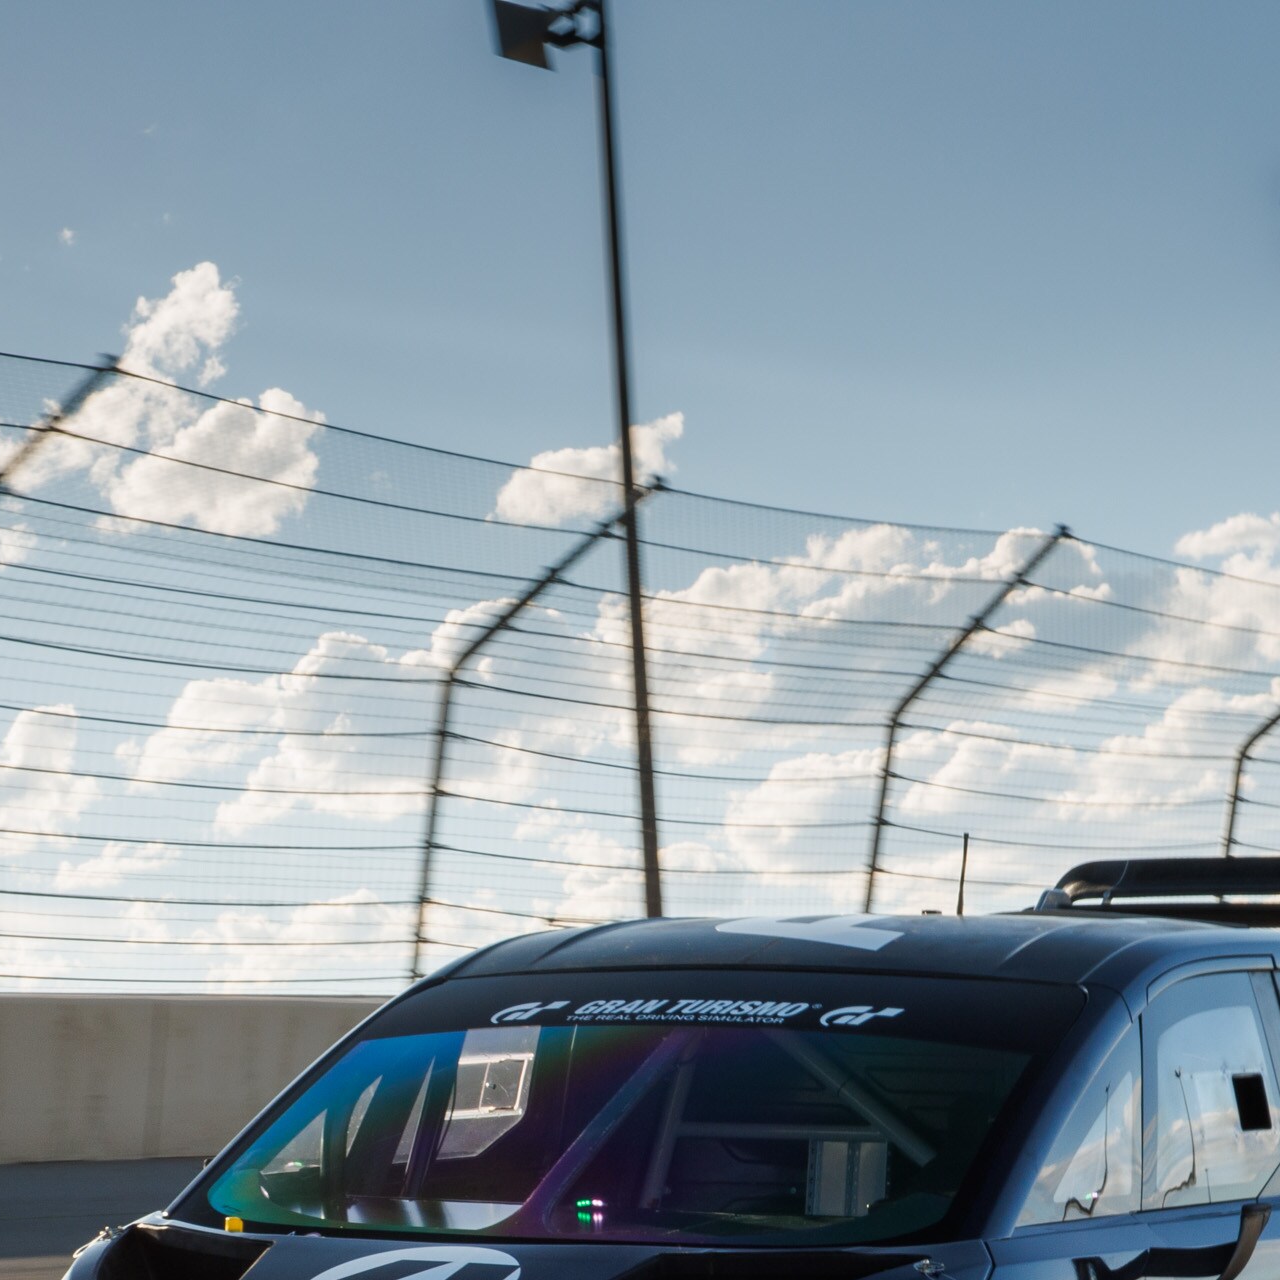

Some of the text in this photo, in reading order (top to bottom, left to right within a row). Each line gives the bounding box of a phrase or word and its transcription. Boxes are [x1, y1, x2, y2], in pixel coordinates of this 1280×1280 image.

[574, 999, 810, 1017] GRAN TURISMO
[566, 1014, 785, 1025] THE REAL DRIVING SIMULATOR
